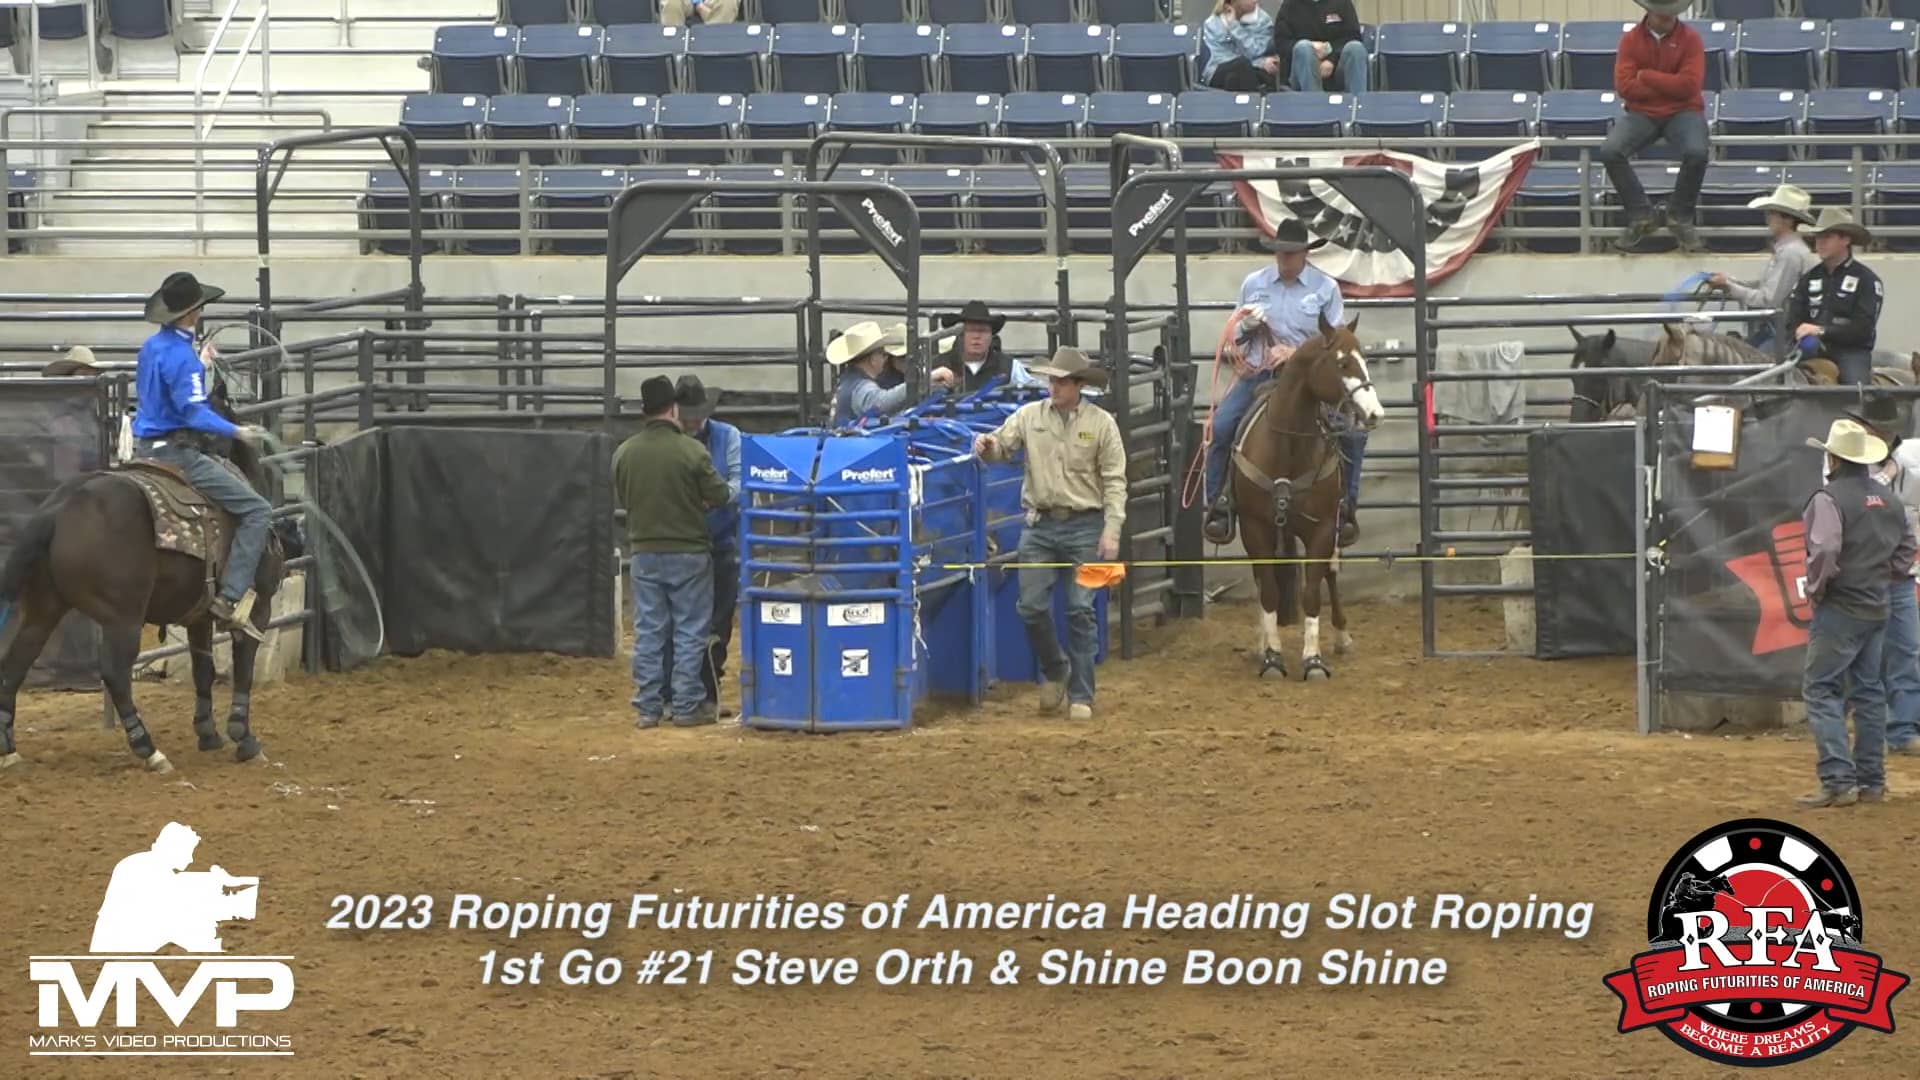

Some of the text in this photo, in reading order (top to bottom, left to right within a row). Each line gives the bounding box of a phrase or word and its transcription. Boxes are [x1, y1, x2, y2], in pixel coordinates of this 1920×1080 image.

[861, 198, 903, 245] Priefert
[1128, 192, 1171, 237] Priefert
[750, 465, 788, 479] Priefert
[841, 467, 895, 481] Priefert
